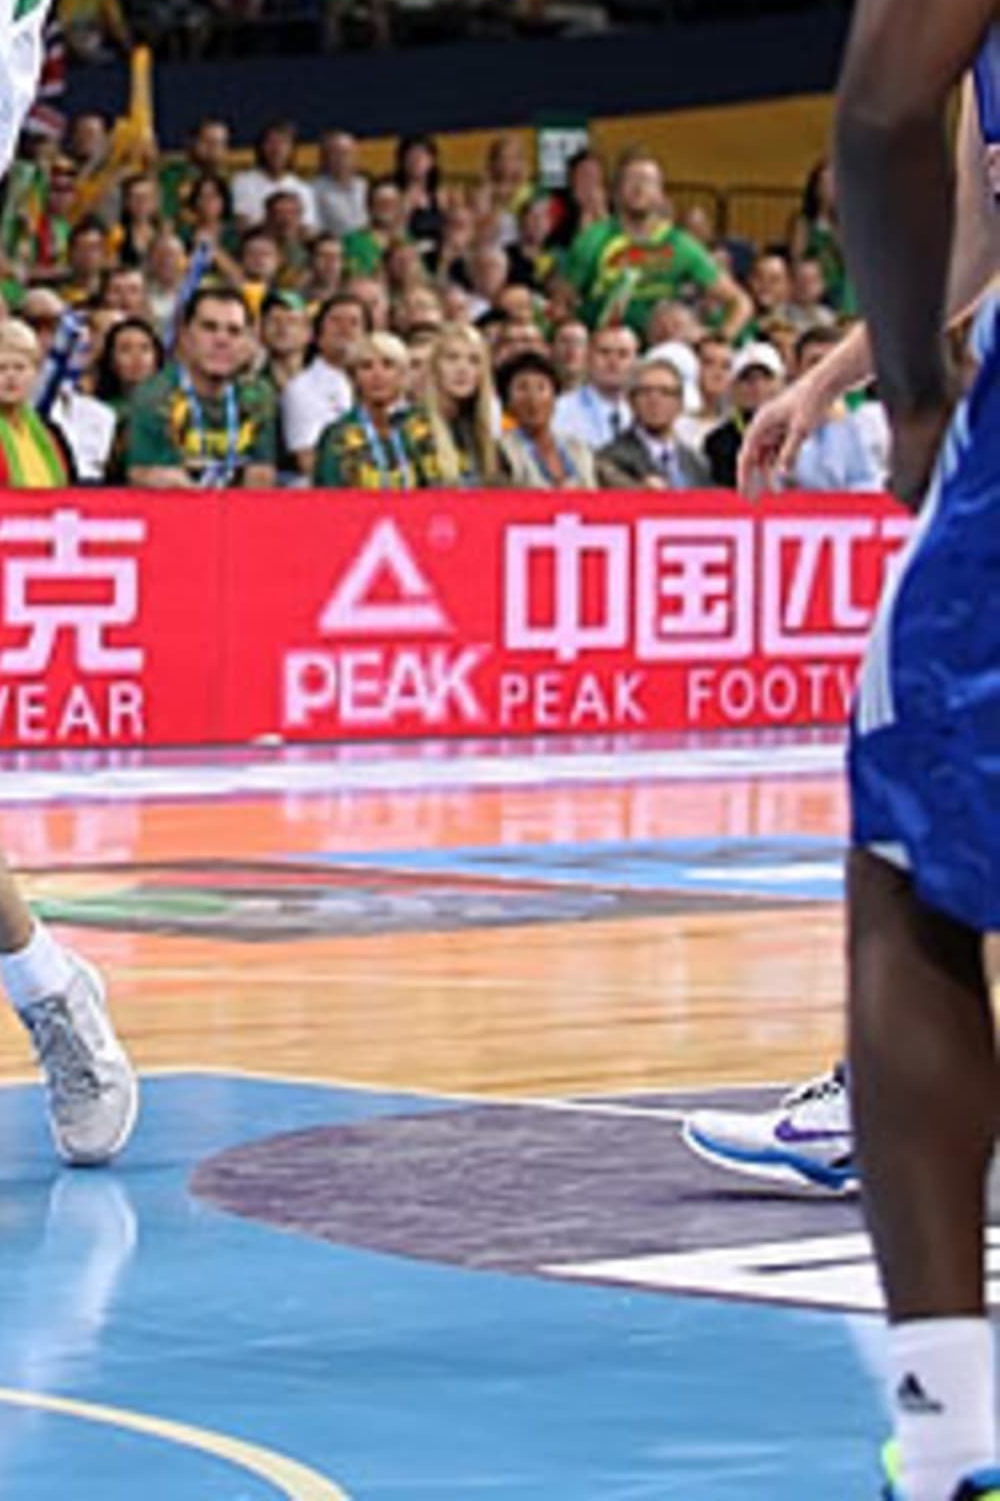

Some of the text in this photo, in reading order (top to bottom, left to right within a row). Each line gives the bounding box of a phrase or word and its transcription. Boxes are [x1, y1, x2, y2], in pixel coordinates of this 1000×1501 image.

[504, 512, 918, 659] 中国匹
[281, 644, 491, 729] PEAK
[502, 663, 862, 726] PEAK FOOT
